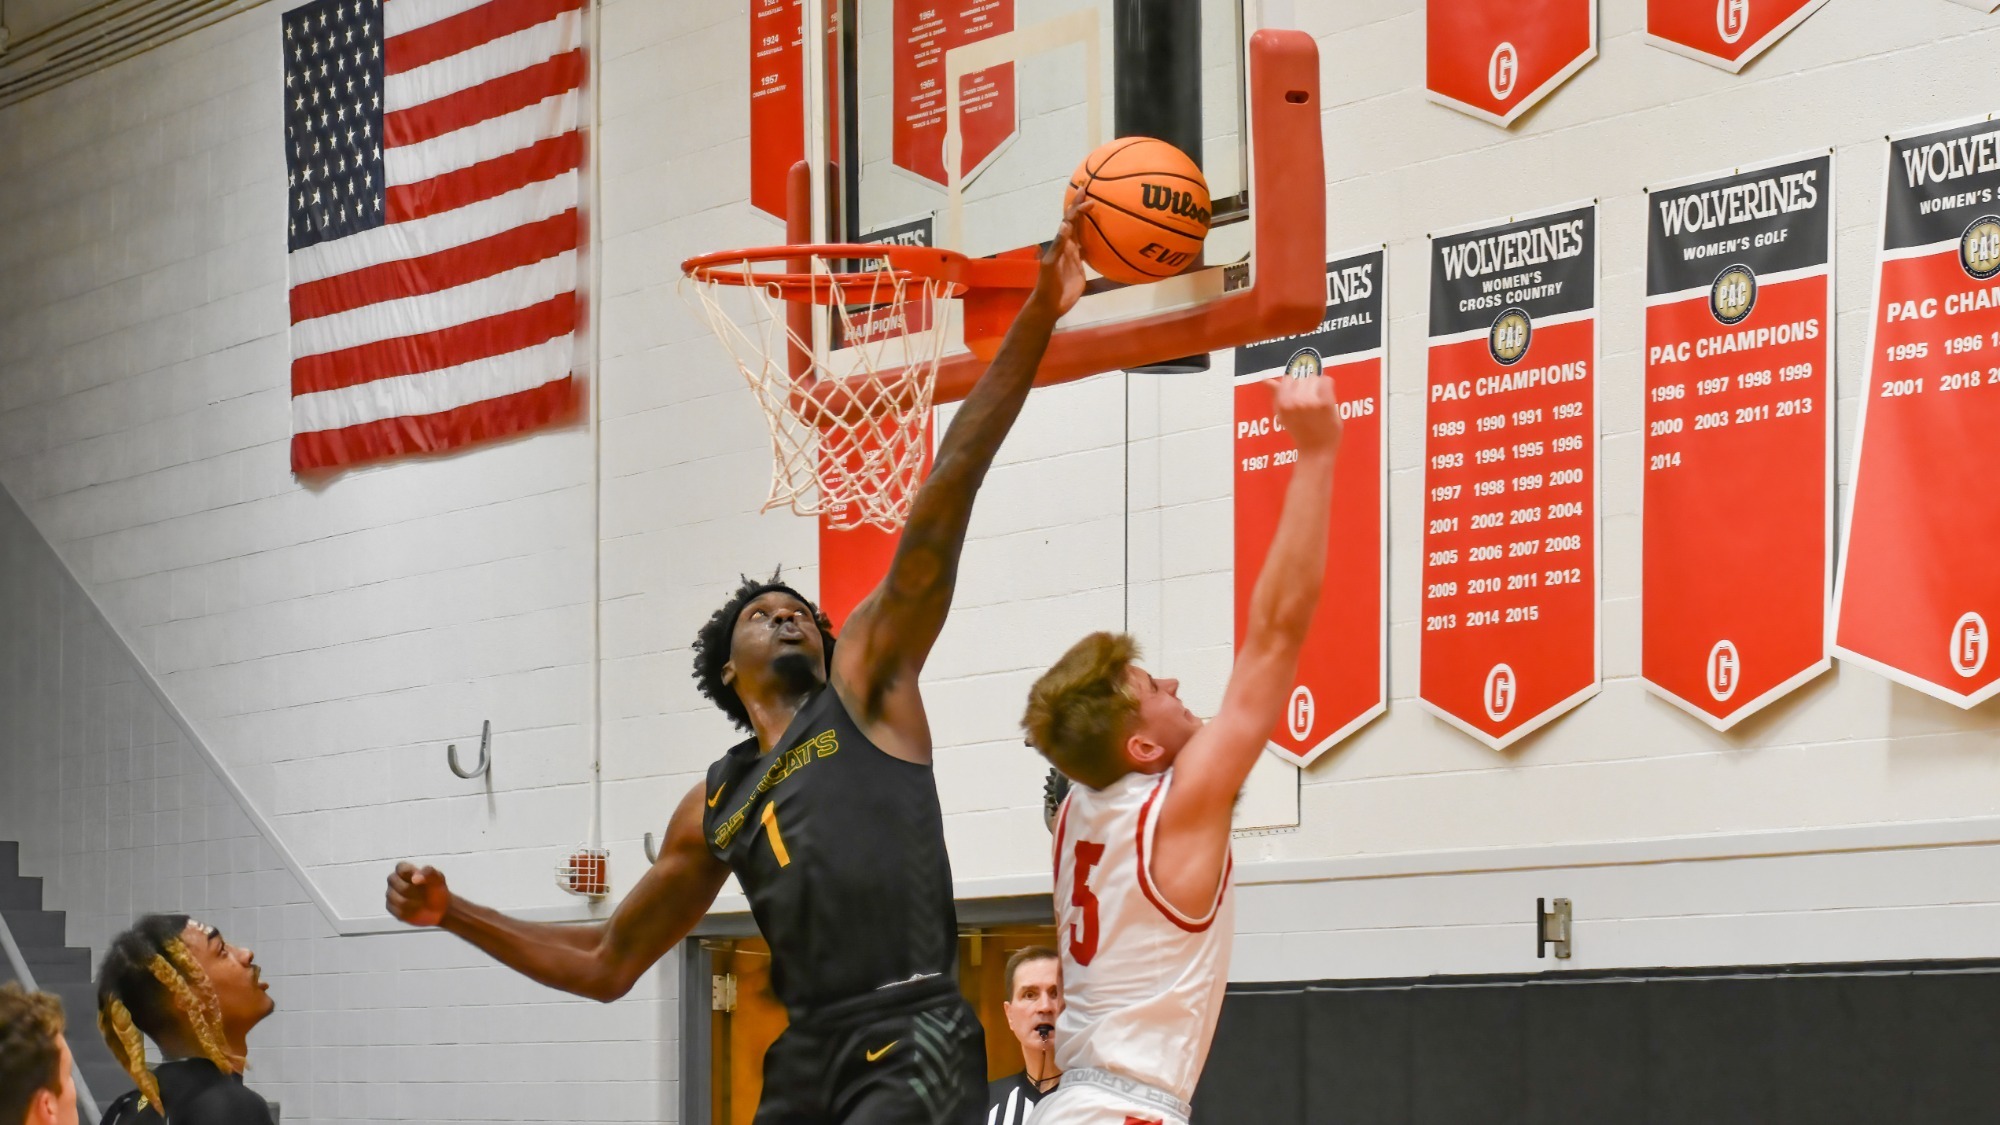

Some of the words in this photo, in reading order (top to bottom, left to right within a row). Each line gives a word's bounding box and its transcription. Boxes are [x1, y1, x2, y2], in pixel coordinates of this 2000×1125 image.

[1496, 47, 1512, 94] G
[1141, 183, 1211, 225] Wilso
[1660, 170, 1817, 237] WOLVERINES
[1920, 188, 1992, 215] WOMEN'S
[1441, 219, 1583, 281] WOLVERINES
[1683, 236, 1750, 261] WOMEN'S
[1754, 229, 1788, 249] GOLF
[1970, 233, 2000, 263] PAC
[1459, 293, 1502, 312] CROSS
[1506, 282, 1563, 304] COUNTRY
[1482, 271, 1542, 293] WOMEN'S
[1720, 282, 1747, 309] PAC
[1301, 312, 1372, 337] SKETBALL
[1887, 298, 1937, 323] PAC
[1498, 325, 1523, 350] PAC
[1650, 342, 1691, 366] PAC
[1696, 318, 1819, 358] CHAMPIONS
[1887, 342, 1928, 362] 1995
[1944, 334, 1982, 355] 1996
[1431, 381, 1471, 403] PAC
[1476, 360, 1587, 396] CHAMPIONS
[1651, 384, 1685, 402] 1996
[1697, 377, 1730, 396] 1997
[1737, 369, 1772, 389] 1998
[1779, 362, 1813, 383] 1999
[1881, 378, 1924, 398] 2001
[1939, 370, 1980, 392] 2018
[1237, 417, 1269, 439] PAC
[1432, 420, 1466, 438] 1989
[1476, 414, 1506, 433] 1990
[1512, 408, 1542, 427] 1991
[1552, 402, 1583, 421] 1992
[1650, 417, 1683, 437] 2000
[1694, 411, 1729, 430] 2003
[1735, 404, 1769, 424] 2011
[1776, 397, 1812, 418] 2013
[1241, 455, 1269, 472] 1987
[1273, 449, 1298, 467] 2020
[1431, 452, 1463, 470] 1993
[1475, 447, 1505, 465] 1994
[1512, 441, 1544, 459] 1995
[1552, 435, 1583, 454] 1996
[1650, 451, 1681, 470] 2014
[1430, 485, 1462, 502] 1997
[1473, 479, 1505, 498] 1998
[1512, 474, 1543, 492] 1999
[1549, 468, 1583, 487] 2000
[1429, 517, 1459, 535] 2001
[1470, 512, 1504, 530] 2002
[1509, 507, 1541, 526] 2003
[1547, 501, 1583, 521] 2004
[1429, 550, 1458, 567] 2005
[1469, 545, 1503, 562] 2006
[1508, 540, 1540, 558] 2007
[1545, 535, 1581, 554] 2008
[1428, 582, 1457, 599] 2009
[1467, 577, 1501, 595] 2010
[1507, 573, 1538, 591] 2011
[1545, 568, 1581, 586] 2012
[1426, 614, 1457, 631] 2013
[1466, 610, 1500, 627] 2014
[1505, 605, 1539, 623] 2015
[1959, 619, 1980, 670] G
[1714, 646, 1733, 694] G
[1491, 670, 1509, 716] G
[1295, 692, 1309, 734] G
[760, 800, 791, 868] 1
[1069, 840, 1105, 967] 5
